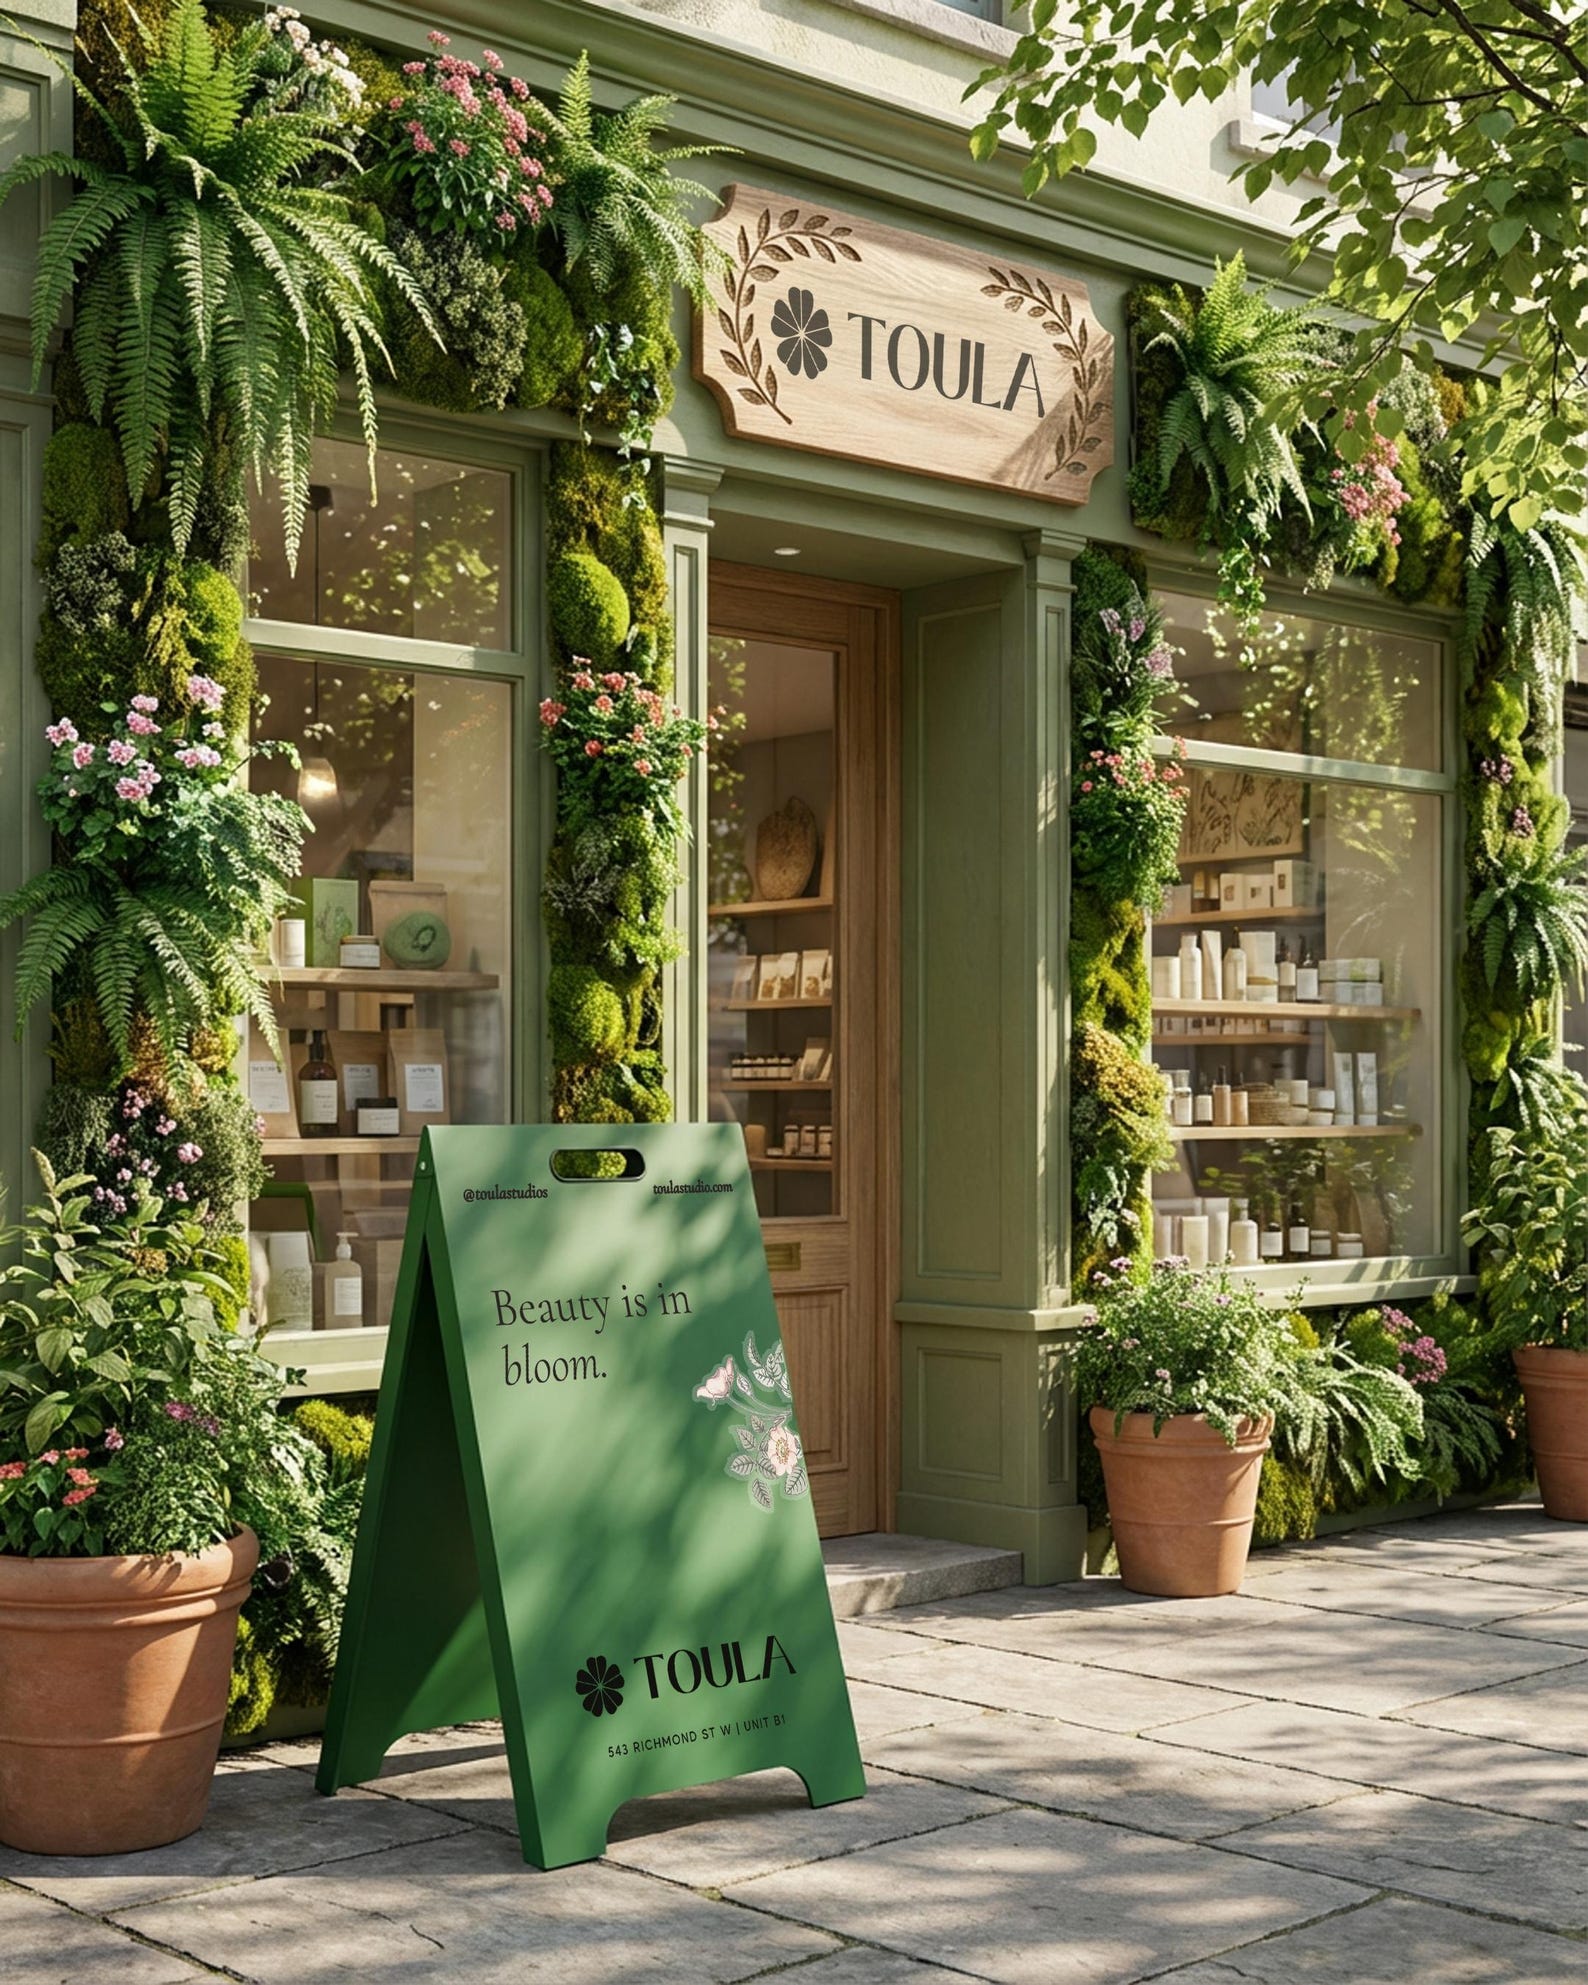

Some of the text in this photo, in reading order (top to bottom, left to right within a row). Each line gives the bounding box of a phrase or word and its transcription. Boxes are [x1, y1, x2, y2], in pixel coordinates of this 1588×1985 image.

[847, 312, 1046, 418] TOULA
[463, 1183, 549, 1203] @toulastudios
[653, 1179, 733, 1195] toulastudio.com
[491, 1282, 692, 1335] Beauty is in
[501, 1343, 607, 1386] bloom.
[633, 1635, 797, 1699] TOULA
[608, 1743, 629, 1758] 543
[633, 1731, 697, 1753] RICHMOND
[702, 1727, 716, 1740] ST
[720, 1724, 731, 1736] W
[743, 1717, 769, 1732] UNIT
[774, 1714, 786, 1726] B1
